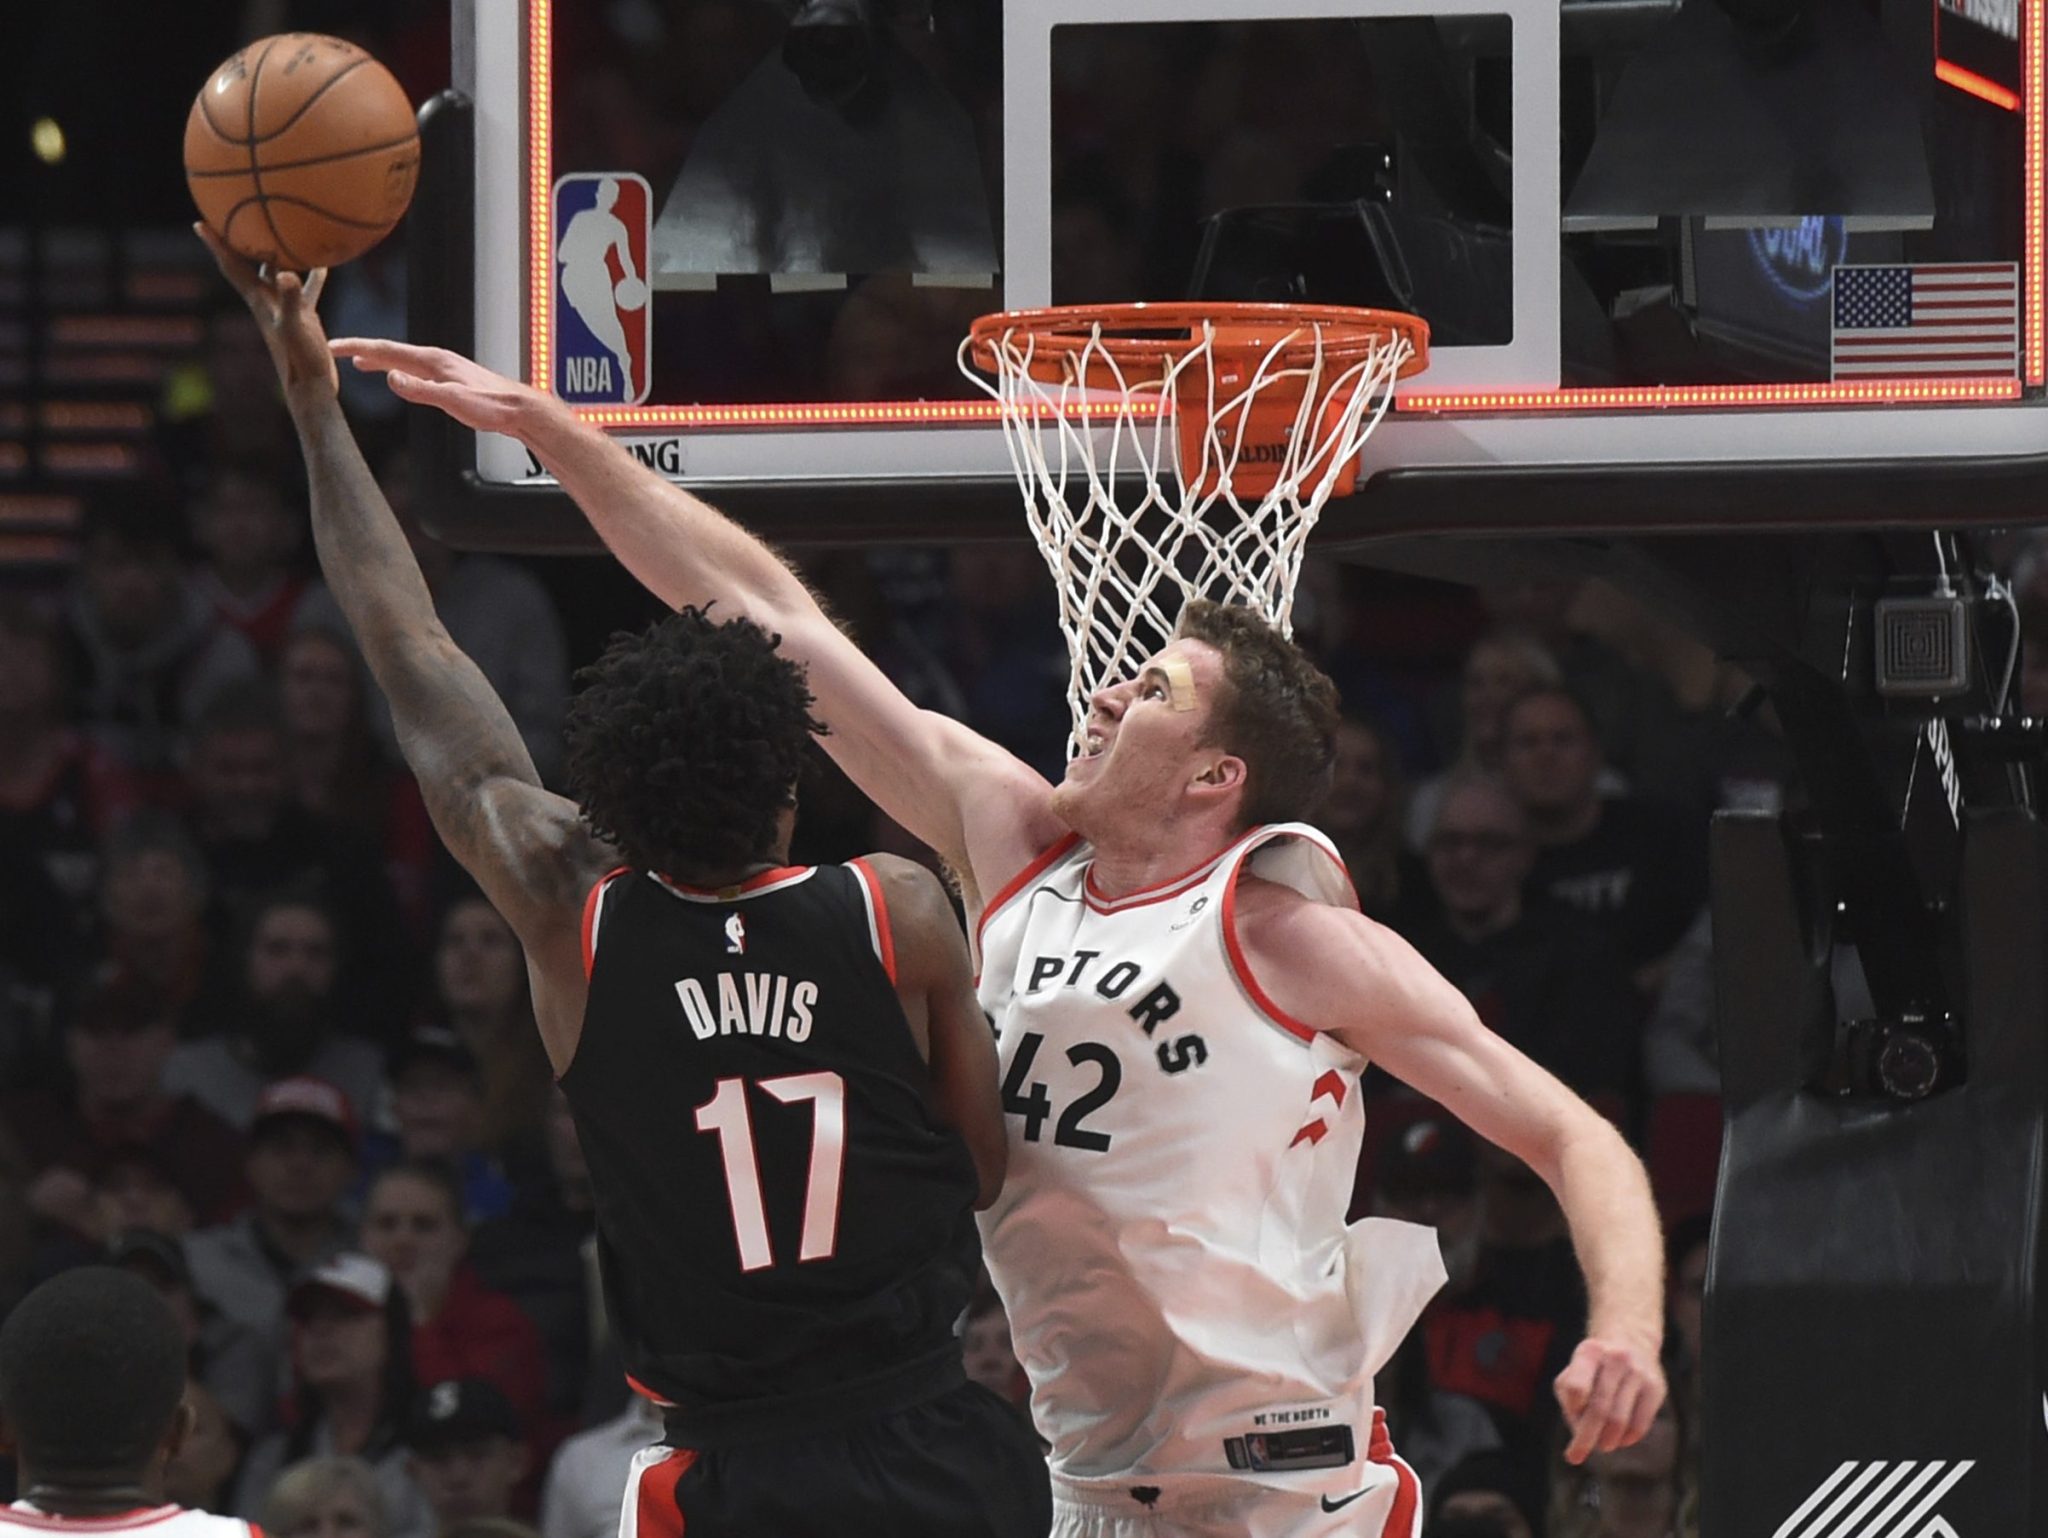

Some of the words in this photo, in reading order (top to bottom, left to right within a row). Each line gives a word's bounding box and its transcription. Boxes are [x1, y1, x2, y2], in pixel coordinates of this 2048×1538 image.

[566, 357, 613, 393] NBA
[674, 972, 819, 1043] DAVIS
[984, 950, 1209, 1077] PTORS
[1001, 1031, 1122, 1153] 42
[692, 1069, 847, 1273] 17
[1254, 1414, 1267, 1425] WE
[1271, 1411, 1290, 1424] THE
[1293, 1408, 1330, 1421] NORTH
